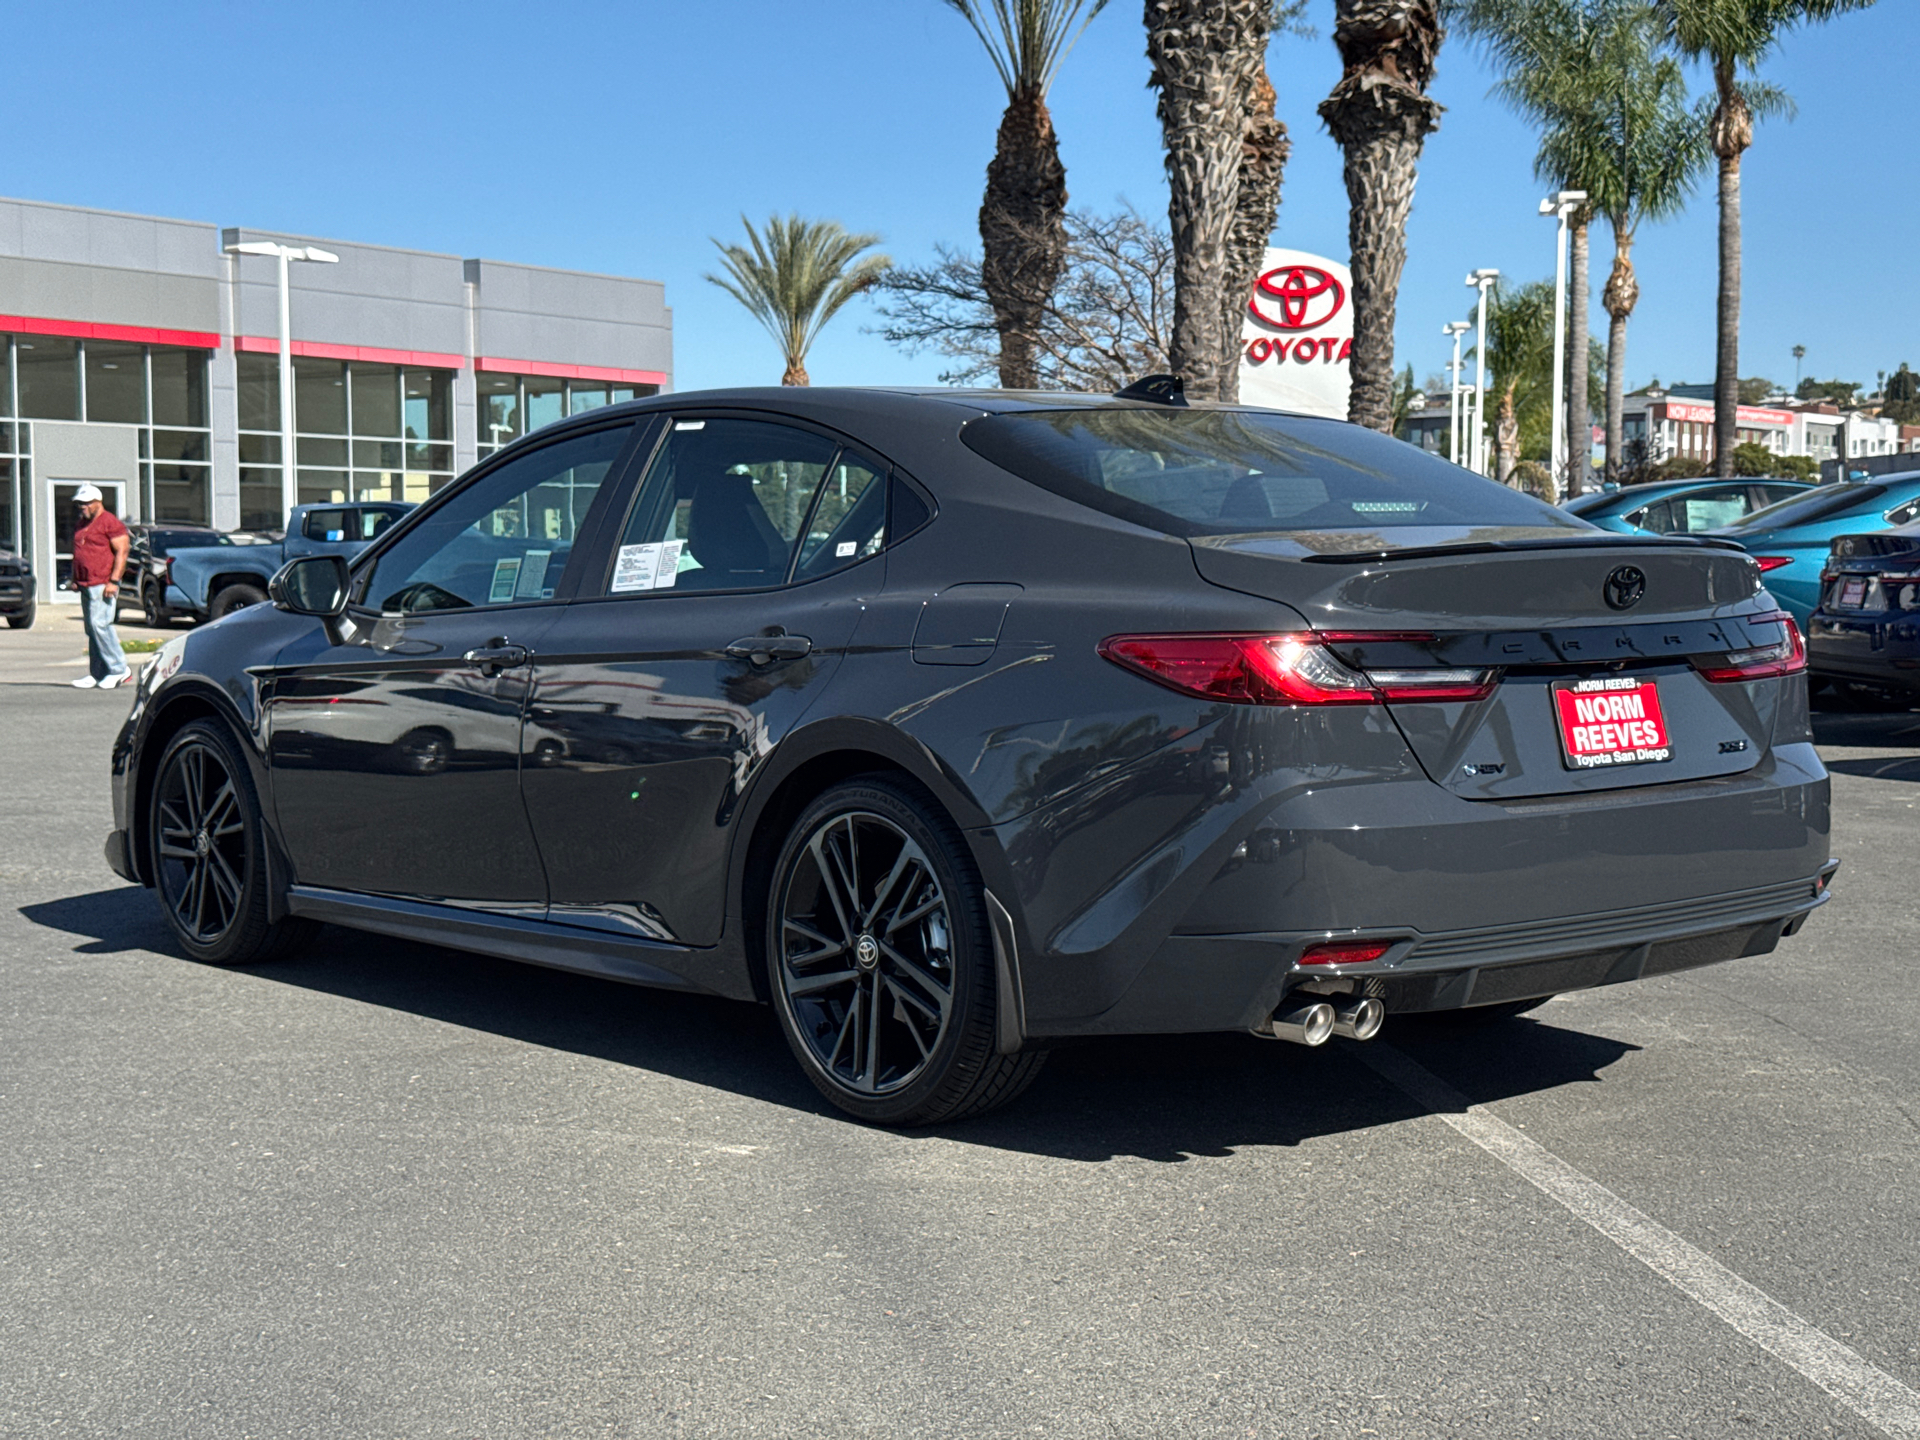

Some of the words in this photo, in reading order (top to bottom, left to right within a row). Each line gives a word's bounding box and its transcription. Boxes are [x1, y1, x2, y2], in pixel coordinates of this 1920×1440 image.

[1502, 631, 1724, 654] CAMRY
[1578, 679, 1604, 692] NORM
[1605, 678, 1635, 690] REEVES
[1575, 694, 1645, 723] NORM
[1572, 720, 1659, 751] REEVES
[1574, 753, 1612, 767] Toyota
[1612, 751, 1636, 763] San
[1636, 748, 1669, 761] Diego
[850, 789, 916, 824] TURANZA
